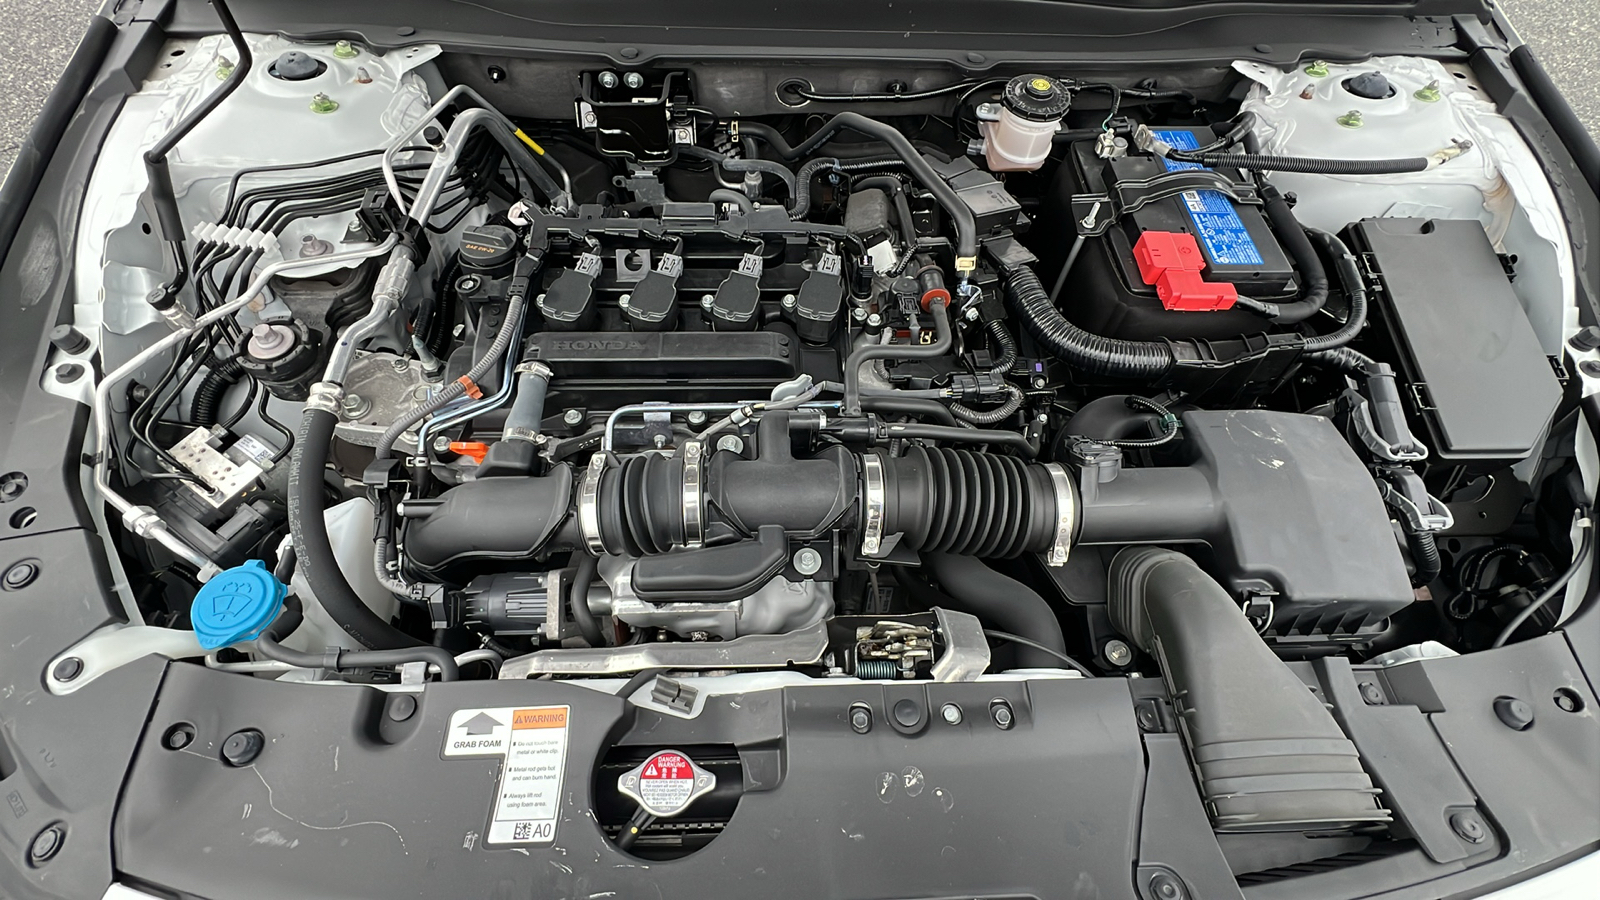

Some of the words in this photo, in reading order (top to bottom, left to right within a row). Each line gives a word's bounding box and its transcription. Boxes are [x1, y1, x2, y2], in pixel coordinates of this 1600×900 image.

[552, 340, 646, 351] HONDA
[524, 713, 565, 724] WARNING
[453, 741, 477, 749] GRAB
[478, 739, 502, 748] FOAM
[532, 823, 552, 839] A0
